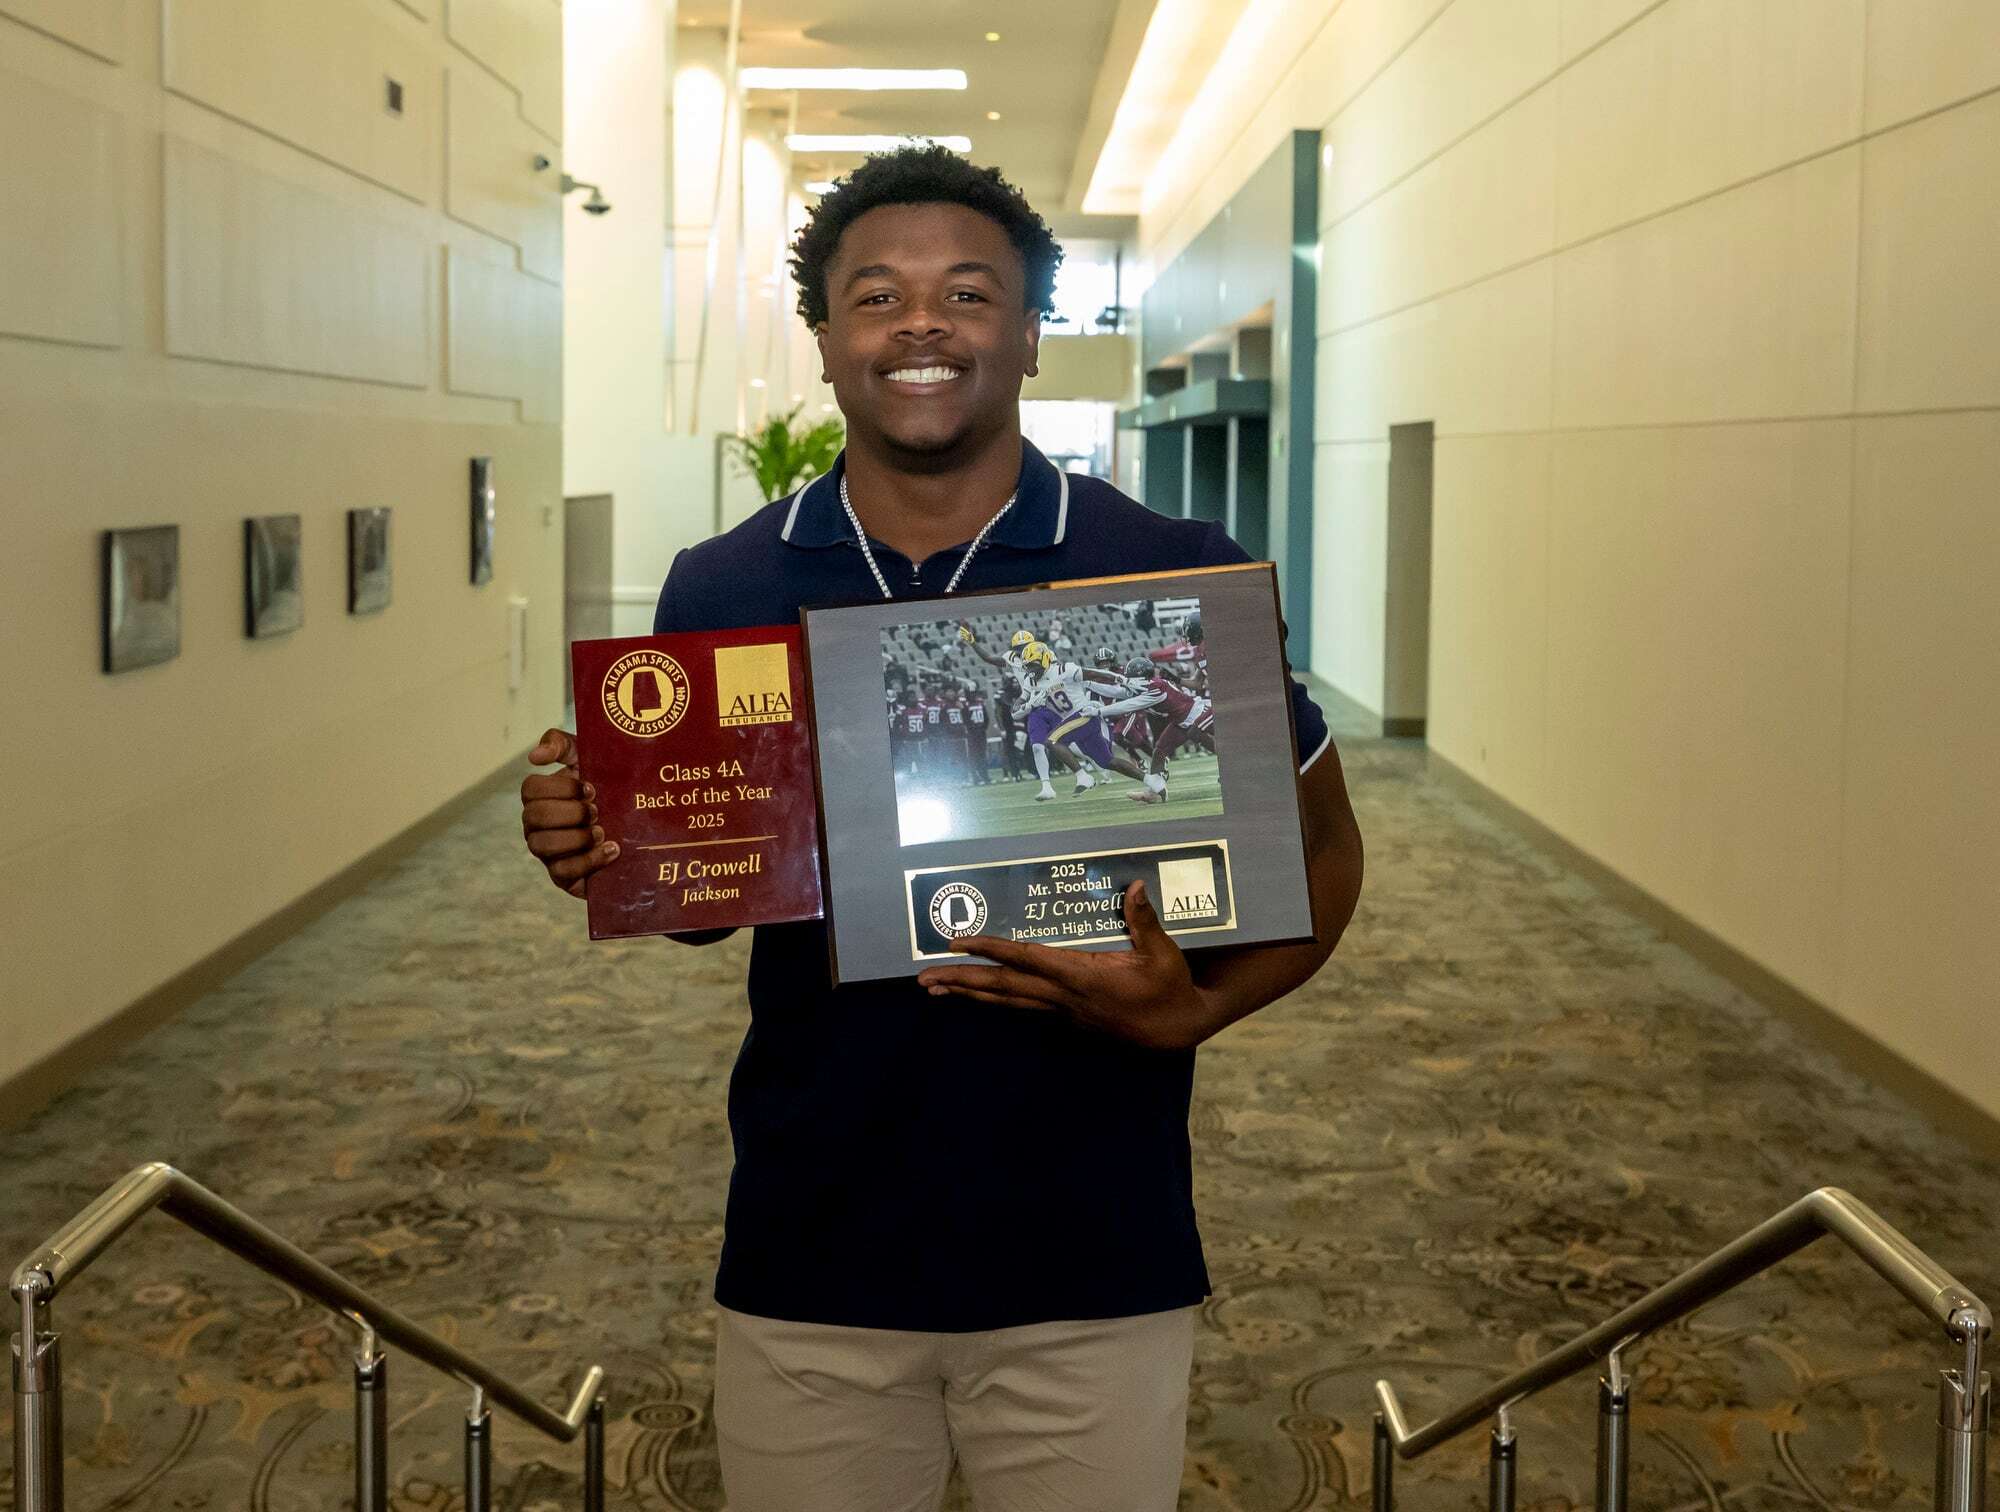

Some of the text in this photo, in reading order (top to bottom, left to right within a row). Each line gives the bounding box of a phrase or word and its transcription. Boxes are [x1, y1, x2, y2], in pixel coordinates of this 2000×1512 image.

[607, 654, 683, 688] ALABAMA SPORTS
[606, 686, 686, 733] WRITERS ASSOCIATION
[729, 691, 791, 716] ALFA
[1047, 690, 1073, 712] 13
[722, 714, 788, 725] INSURANCE
[908, 719, 924, 732] 50
[660, 760, 744, 782] Class 4A
[635, 785, 773, 809] Back of the Year
[687, 812, 725, 829] 2025
[658, 853, 761, 885] EJ Crowell
[1050, 863, 1085, 878] 2025
[681, 886, 740, 906] Jackson
[933, 885, 983, 909] ALABAMA SPORTS
[1027, 876, 1112, 897] Mr. Football
[1024, 892, 1126, 920] EJ Crowell
[1171, 893, 1217, 912] ALFA
[932, 906, 985, 938] WRITERS ASSOCIATION
[1011, 917, 1128, 941] Jackson High Scho
